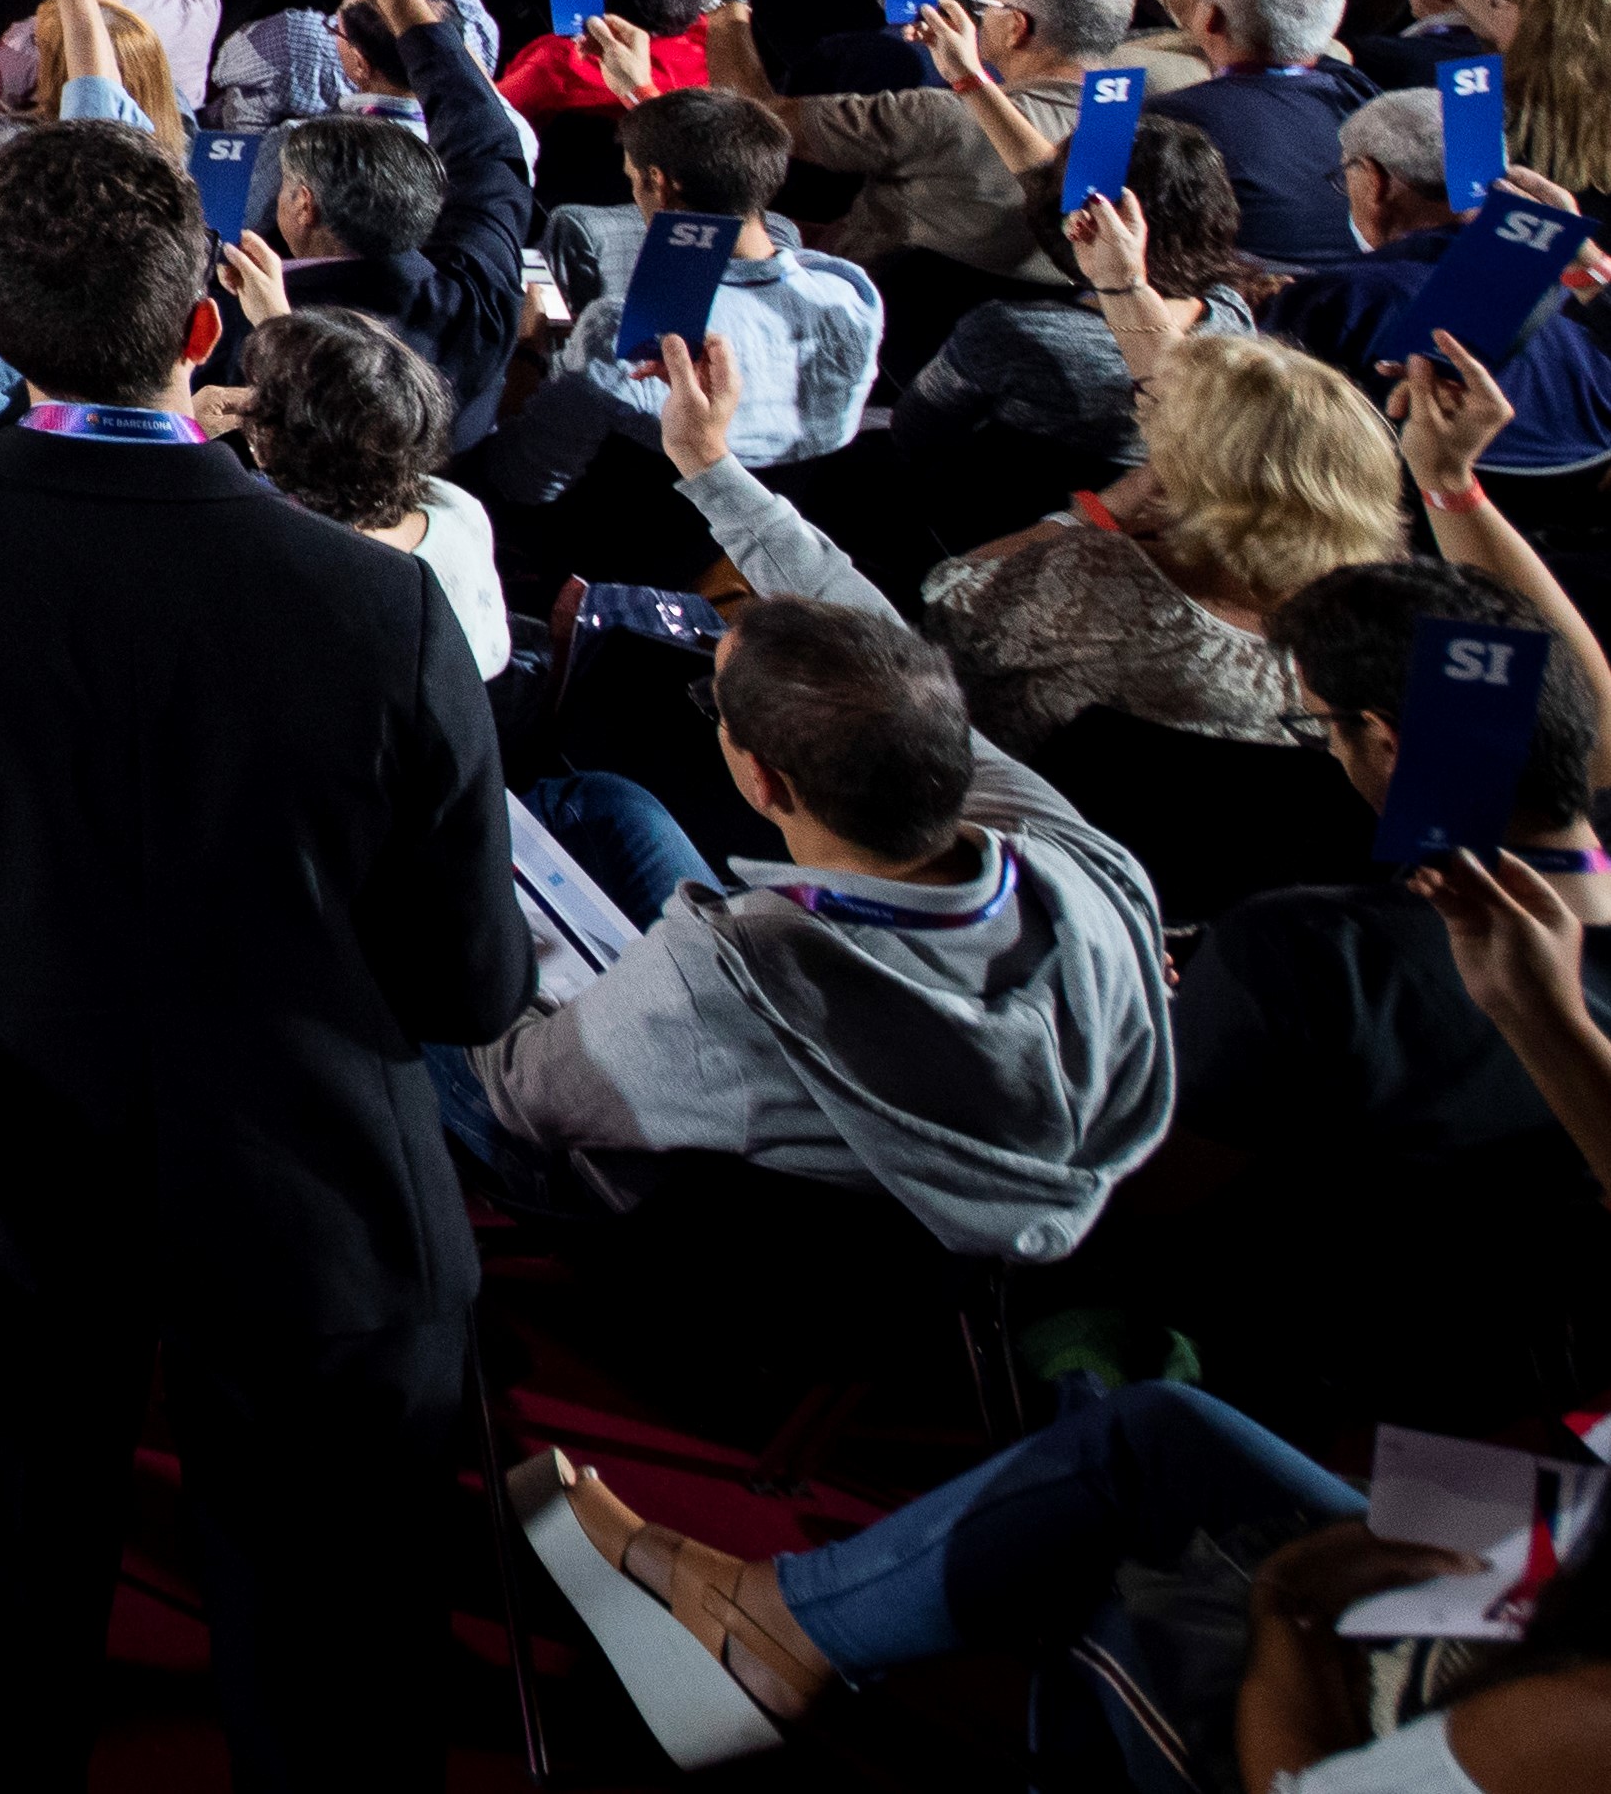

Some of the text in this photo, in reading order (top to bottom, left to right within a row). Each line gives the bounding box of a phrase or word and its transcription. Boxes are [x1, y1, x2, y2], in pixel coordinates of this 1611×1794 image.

[1094, 77, 1130, 103] SI
[1454, 67, 1489, 95] SI
[209, 139, 245, 161] SI
[669, 223, 719, 249] SI
[1496, 211, 1564, 251] SI
[102, 417, 173, 432] FC BARCELONA
[1445, 639, 1513, 685] SI
